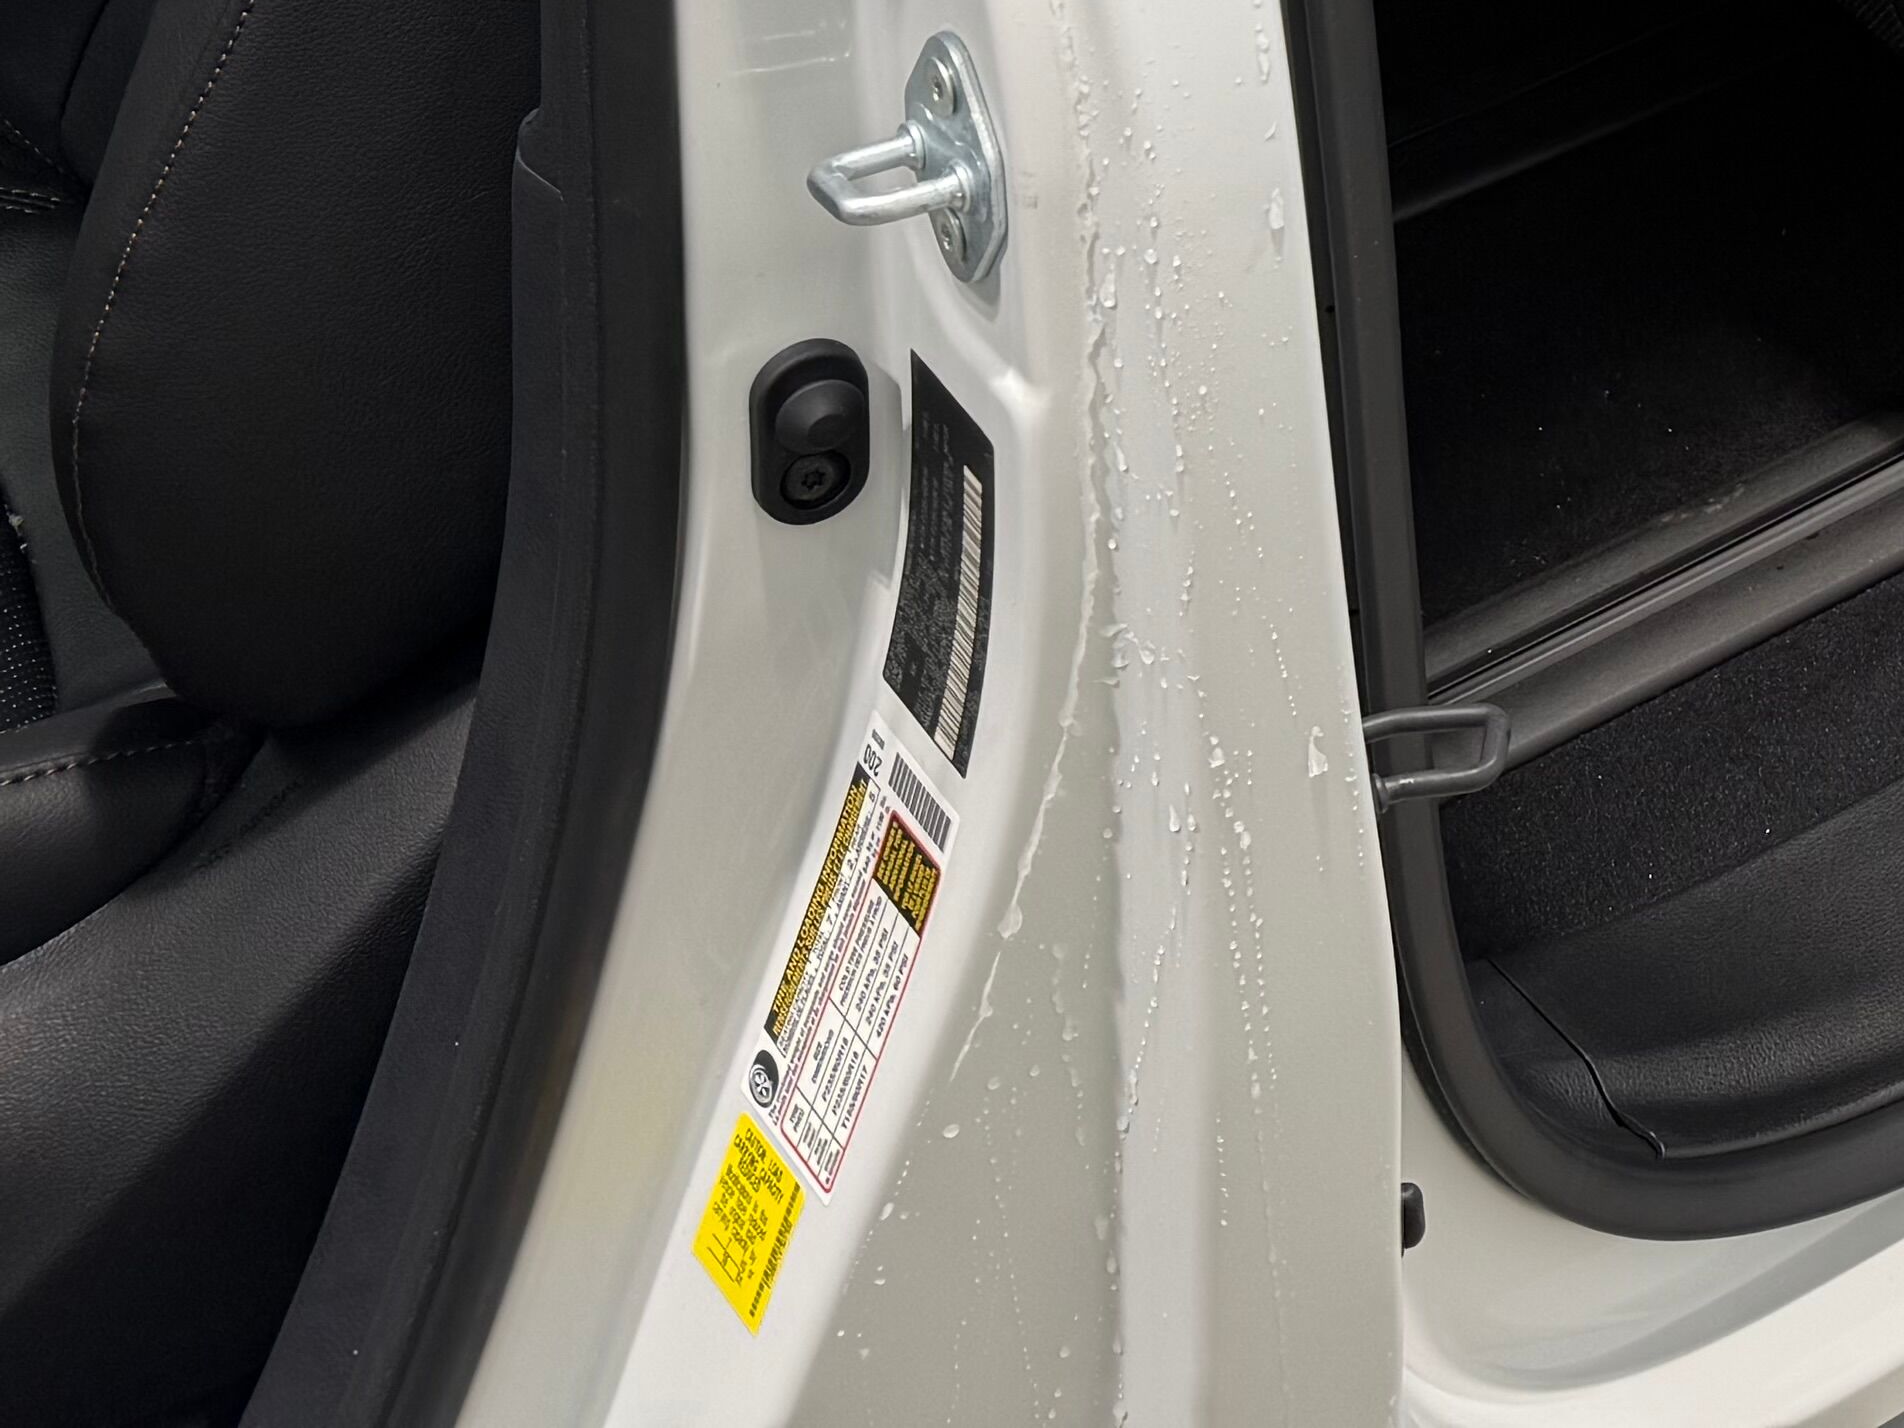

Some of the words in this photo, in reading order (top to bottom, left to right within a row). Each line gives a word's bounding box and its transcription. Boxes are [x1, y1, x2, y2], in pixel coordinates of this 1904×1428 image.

[784, 944, 801, 982] AND
[796, 879, 825, 948] LOADING
[819, 782, 859, 884] INFORMATION
